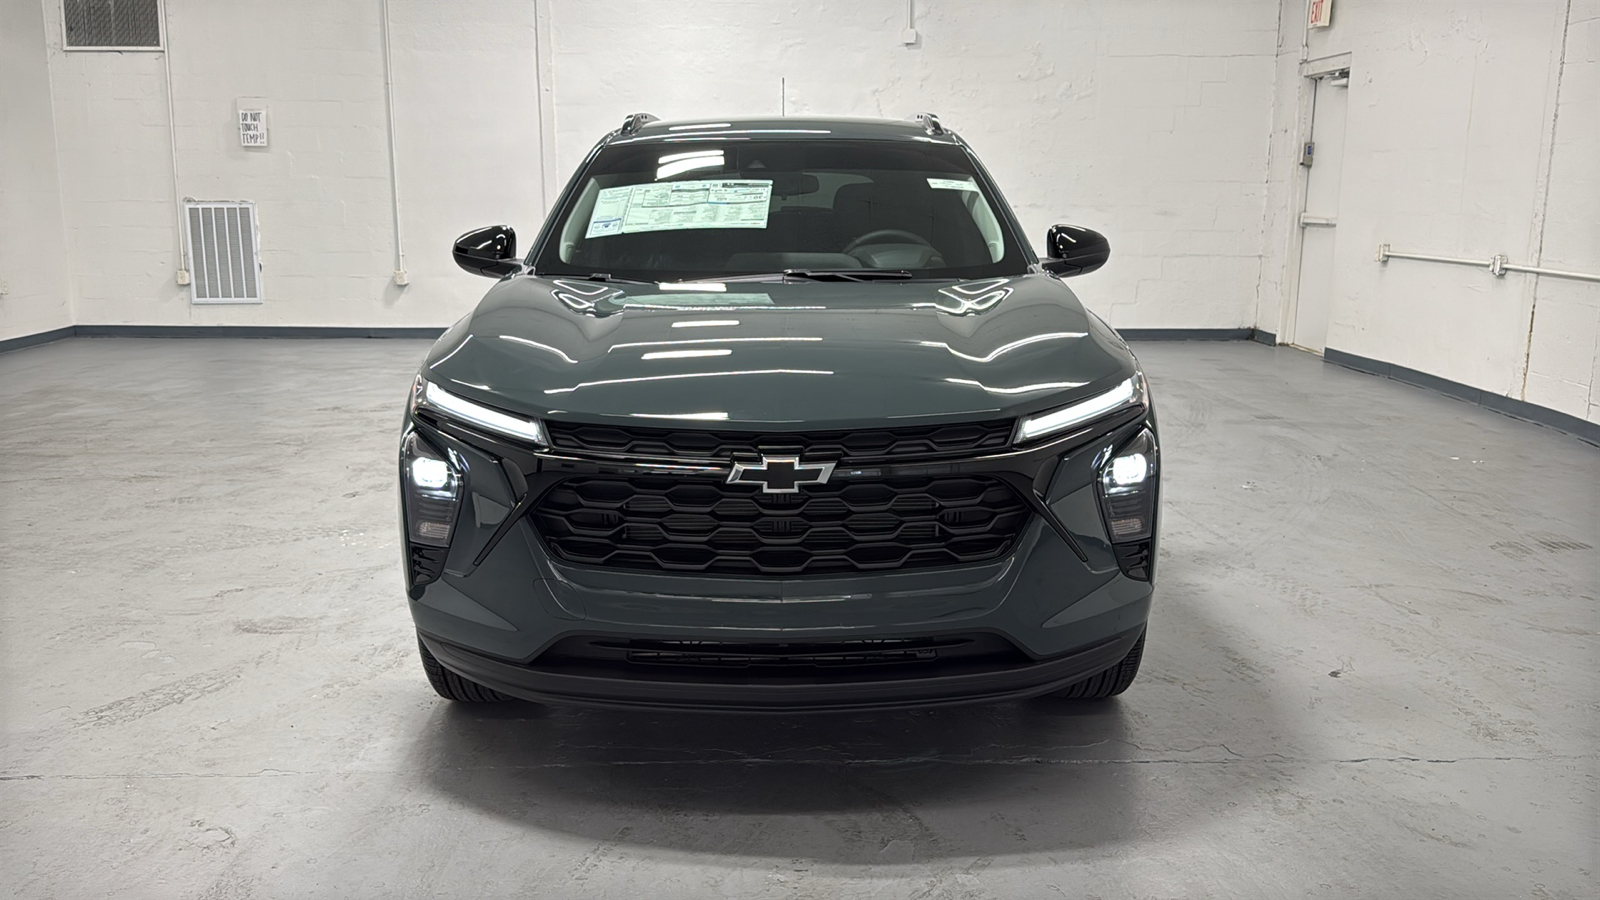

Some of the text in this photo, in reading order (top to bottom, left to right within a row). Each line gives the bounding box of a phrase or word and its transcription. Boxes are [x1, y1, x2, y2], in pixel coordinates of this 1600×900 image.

[1310, 0, 1324, 24] EXIT
[241, 112, 262, 122] DO NOT
[241, 123, 258, 132] TOUCH
[242, 133, 265, 144] TEMP!!
